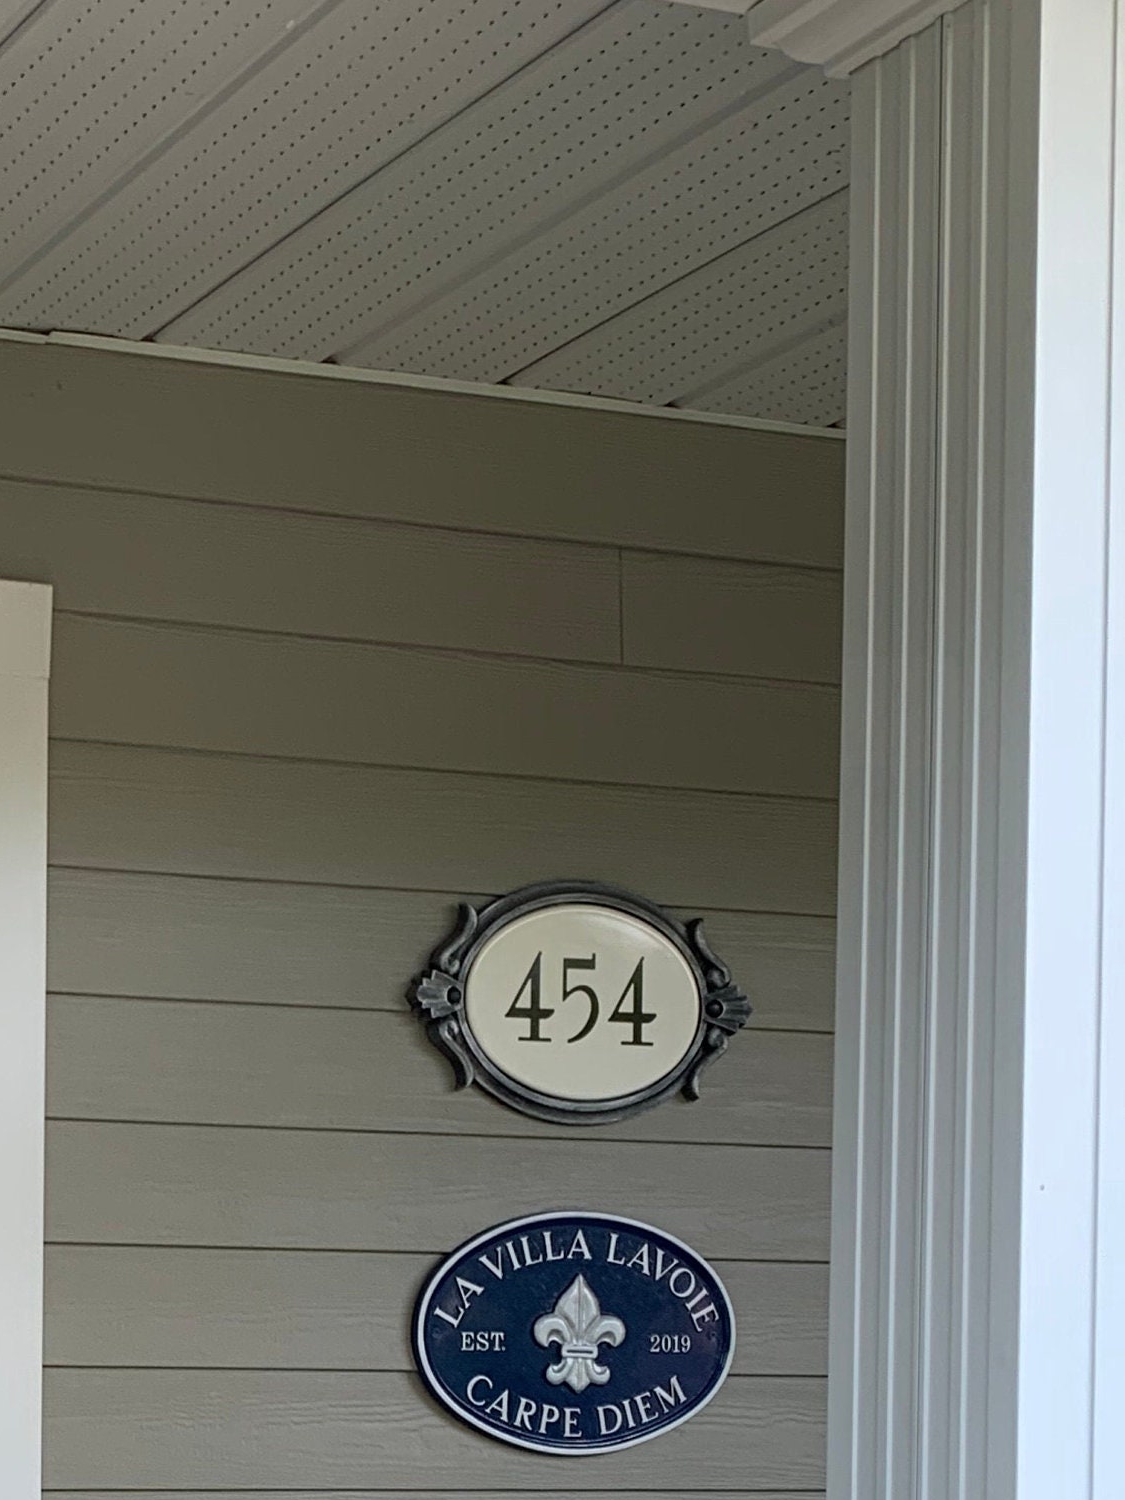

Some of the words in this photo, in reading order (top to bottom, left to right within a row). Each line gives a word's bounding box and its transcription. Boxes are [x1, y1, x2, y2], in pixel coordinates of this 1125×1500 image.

[504, 950, 657, 1046] 454
[434, 1275, 485, 1329] LA
[479, 1229, 592, 1281] VILLA
[606, 1232, 720, 1332] LAVOIE
[461, 1331, 506, 1352] EST.
[649, 1334, 692, 1354] 2019
[466, 1374, 582, 1438] CARPE
[597, 1374, 687, 1435] DIEM
